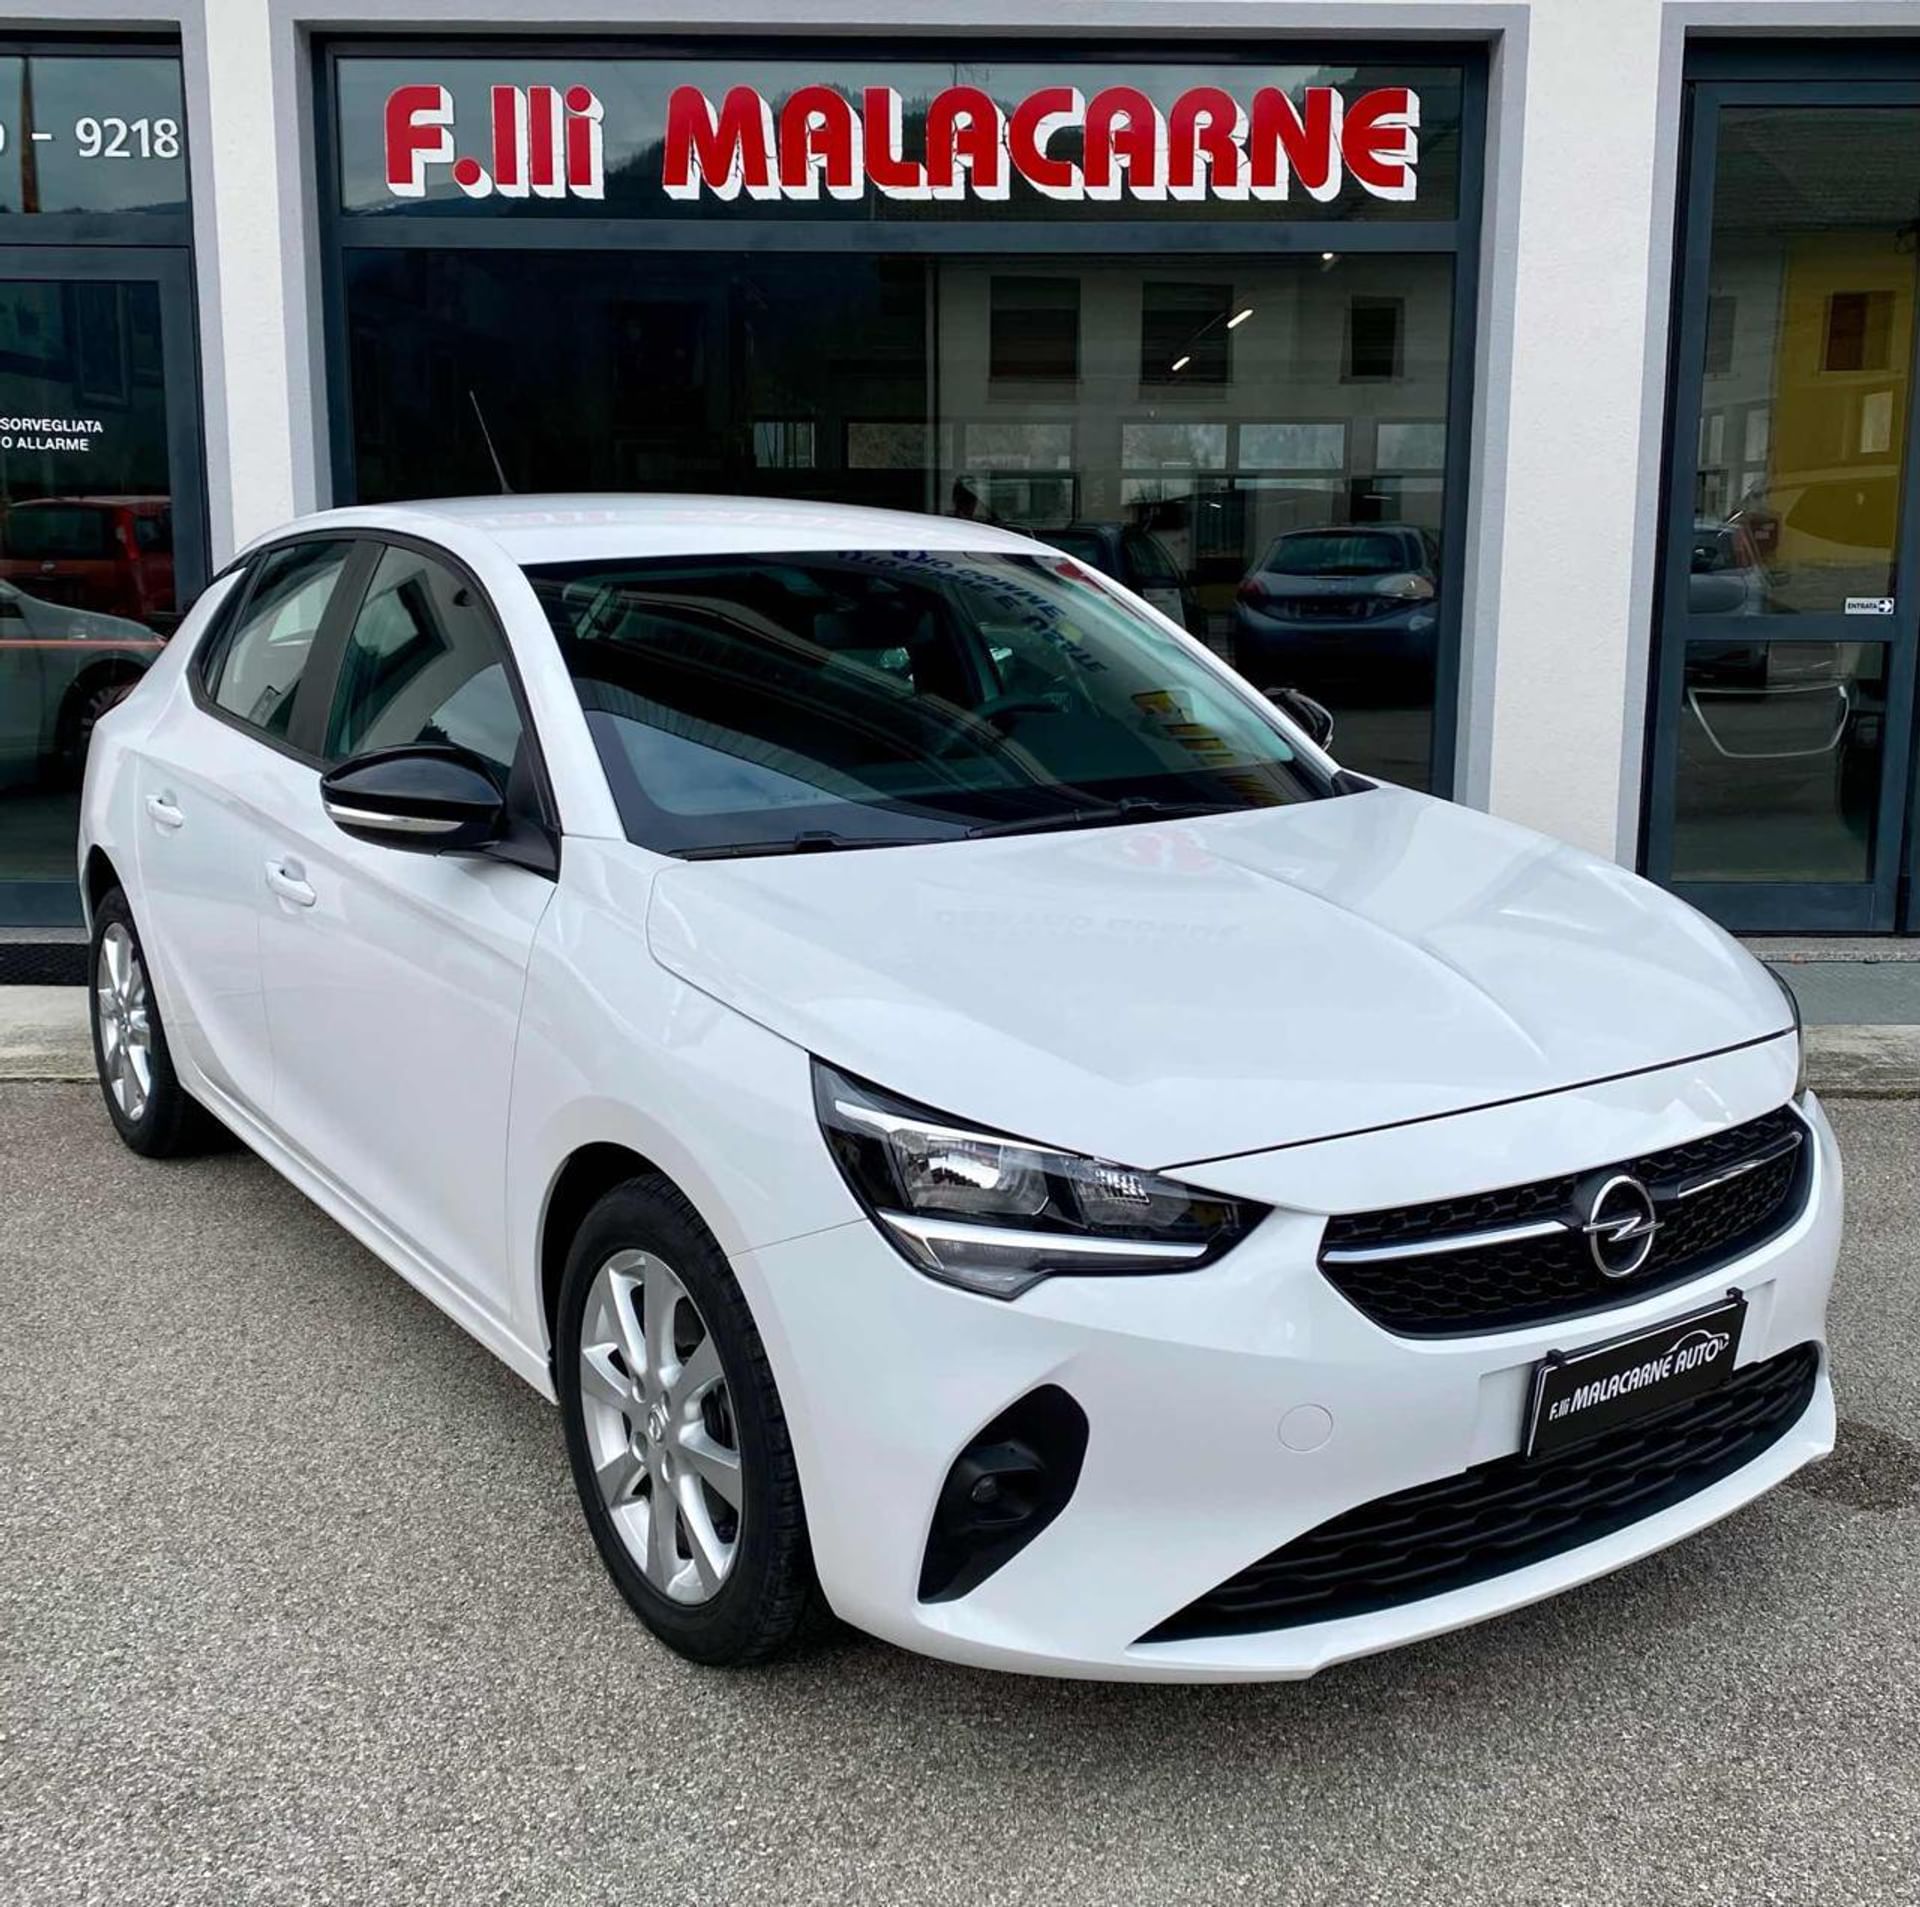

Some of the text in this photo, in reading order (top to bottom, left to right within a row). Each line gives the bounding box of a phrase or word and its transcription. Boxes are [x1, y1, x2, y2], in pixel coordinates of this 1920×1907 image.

[75, 117, 179, 158] 9218
[662, 85, 1420, 202] MALACARNE
[0, 417, 103, 433] SORVEGLIATA
[16, 437, 89, 452] ALLARME
[1847, 602, 1878, 610] ENTRATA
[1570, 1354, 1672, 1413] MALACARNE
[1673, 1337, 1720, 1376] AUTO
